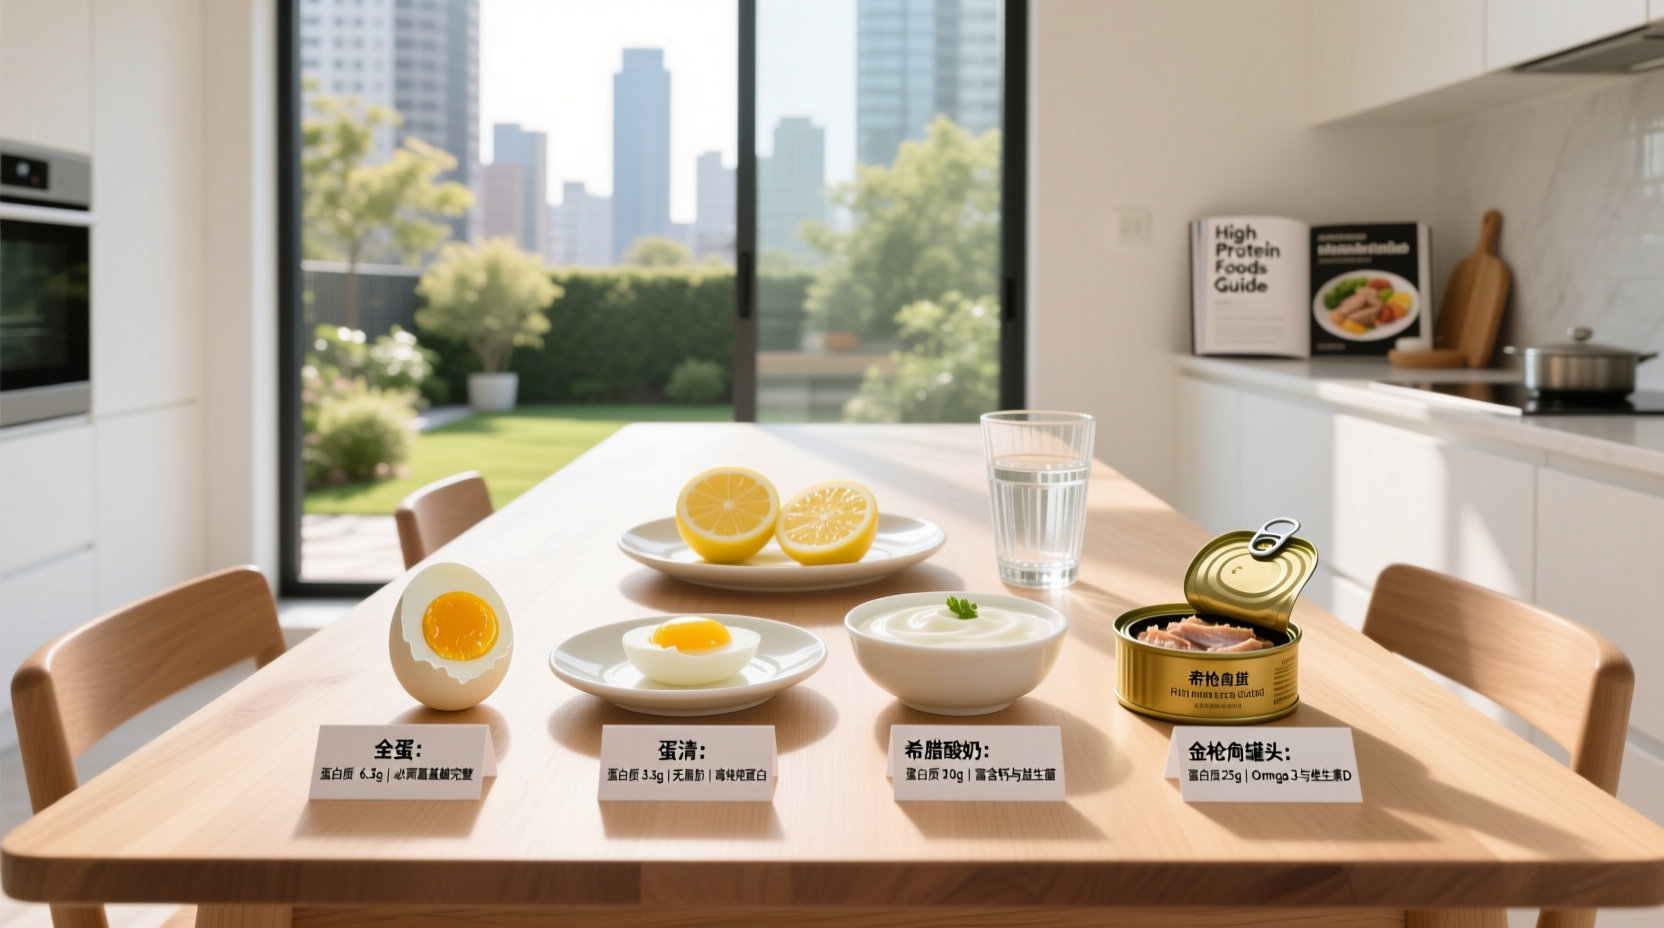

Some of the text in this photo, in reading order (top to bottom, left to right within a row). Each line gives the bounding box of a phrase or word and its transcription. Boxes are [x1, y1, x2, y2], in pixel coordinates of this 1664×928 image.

[1215, 225, 1257, 243] High
[1215, 242, 1281, 258] Protein
[1216, 260, 1267, 275] Foods
[1214, 277, 1268, 293] Guide
